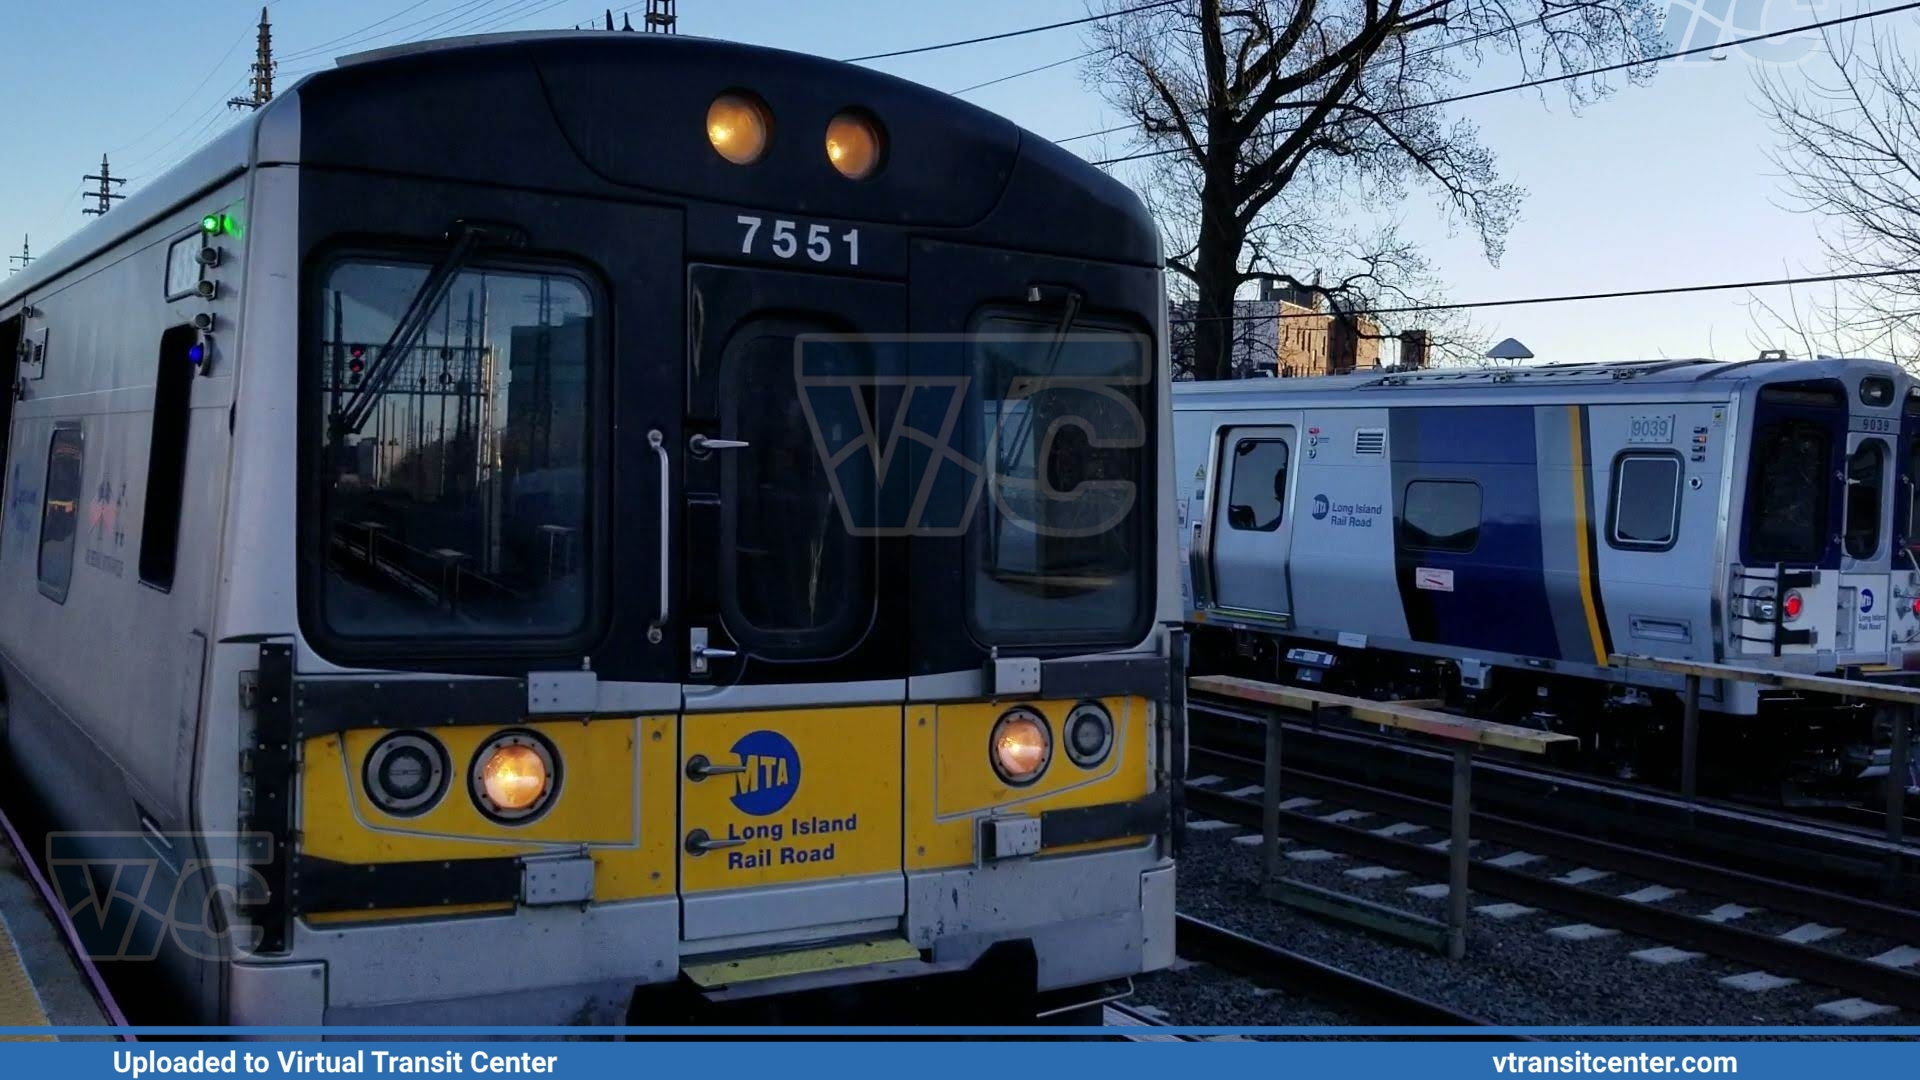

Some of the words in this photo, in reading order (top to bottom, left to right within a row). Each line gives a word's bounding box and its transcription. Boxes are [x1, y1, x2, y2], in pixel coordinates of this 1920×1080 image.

[737, 215, 858, 265] 7551
[1632, 420, 1668, 437] 9039
[1863, 418, 1890, 431] 9039
[1332, 502, 1354, 515] Long
[1355, 503, 1382, 515] Island
[1331, 515, 1347, 526] Rail
[1348, 516, 1372, 528] Road
[728, 822, 783, 841] Long
[792, 813, 857, 836] Island
[728, 848, 771, 870] Rail
[780, 843, 835, 865] Road
